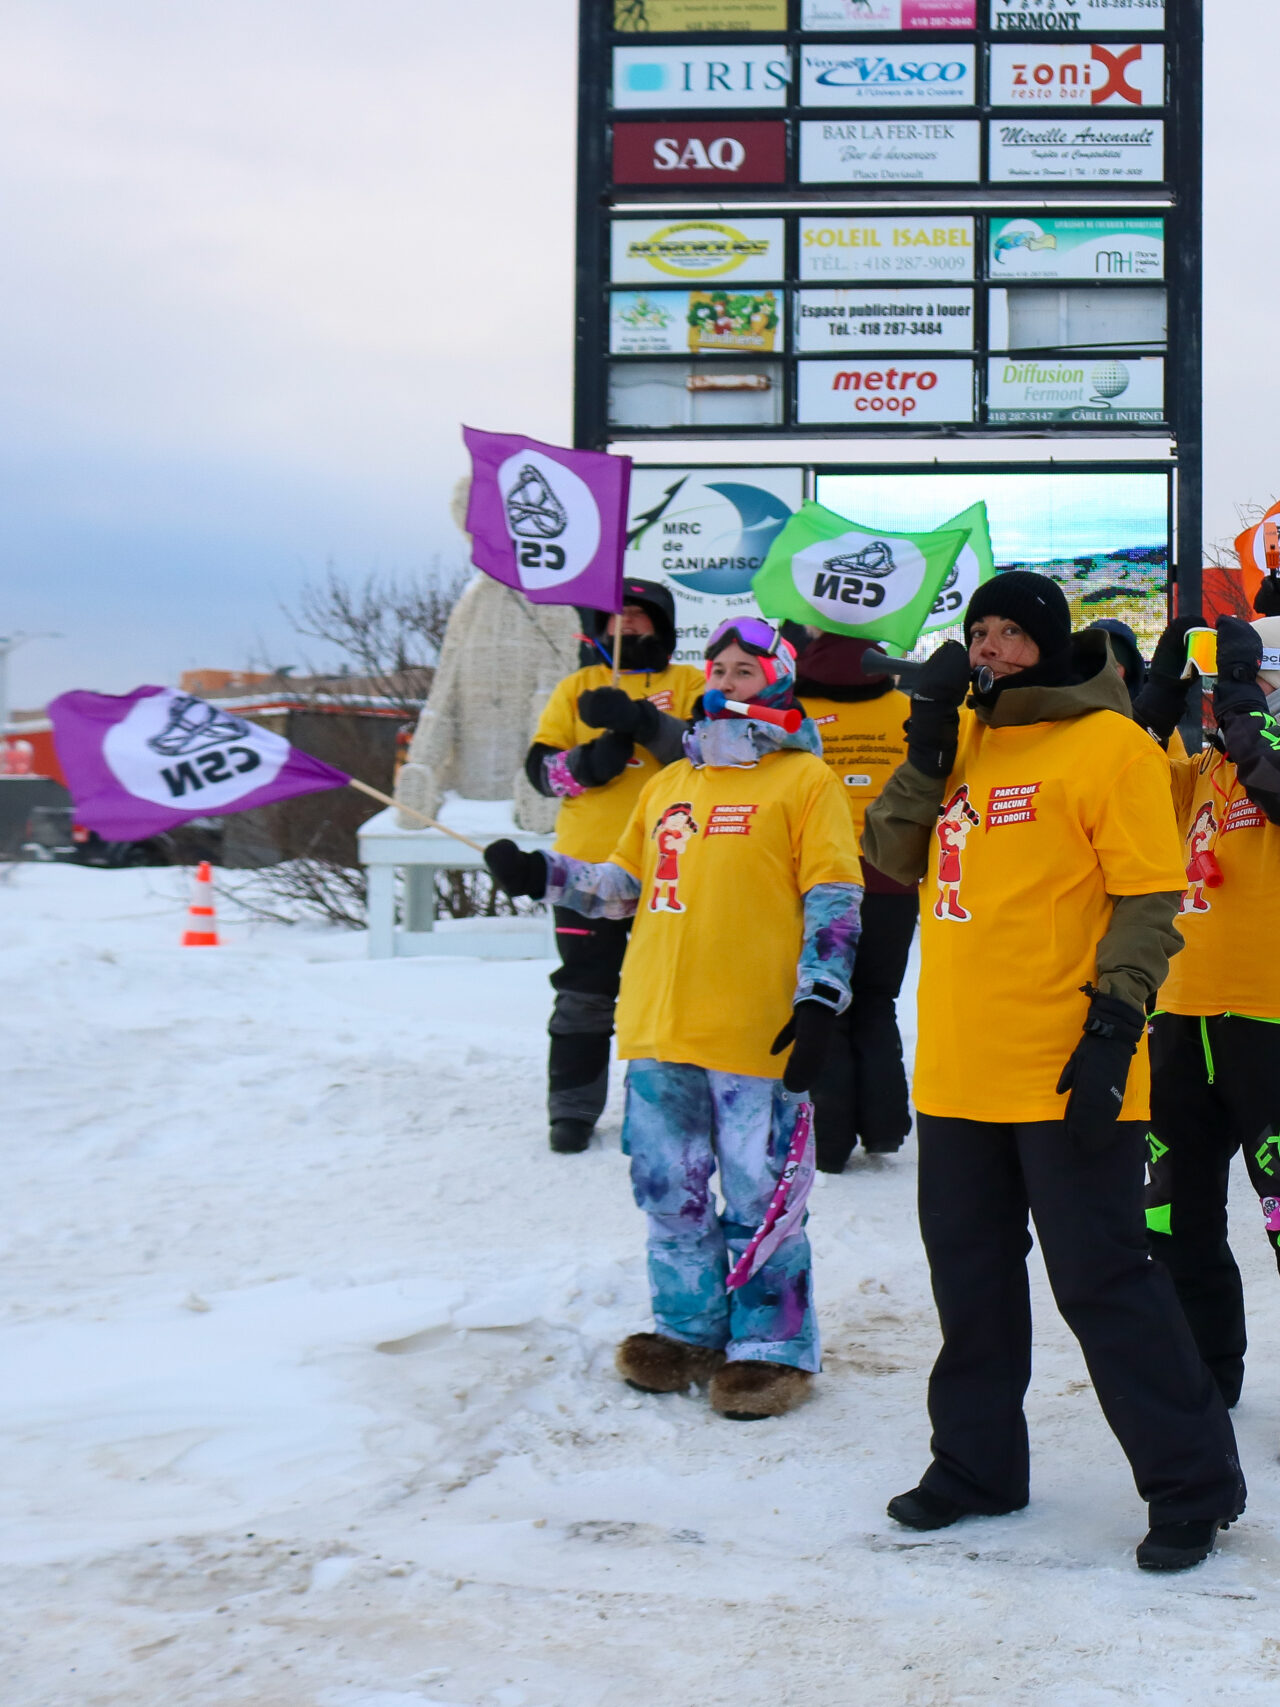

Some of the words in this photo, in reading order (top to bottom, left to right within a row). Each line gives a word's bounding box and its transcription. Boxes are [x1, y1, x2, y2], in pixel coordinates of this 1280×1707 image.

[996, 12, 1080, 30] FERMONT
[681, 60, 787, 91] IRIS
[853, 57, 967, 82] VASCO
[1011, 88, 1052, 98] resto
[1059, 88, 1086, 98] bar
[823, 125, 857, 139] BAR
[860, 125, 884, 139] LA
[887, 124, 955, 140] FER-TEK
[1000, 126, 1068, 144] Mireille
[1070, 126, 1154, 145] Arsenault
[653, 137, 746, 172] SAQ
[803, 228, 882, 247] SOLEIL
[893, 228, 972, 247] ISABEL
[810, 254, 849, 271] TÉL.
[863, 257, 891, 271] 418
[895, 257, 966, 271] 287-9009
[801, 304, 845, 318] Espace
[849, 303, 924, 318] publicitaire
[926, 303, 935, 316] à
[937, 303, 971, 316] louer
[859, 323, 881, 335] 418
[884, 322, 943, 336] 287-3484
[832, 368, 937, 391] metro
[1002, 363, 1085, 384] Diffusion
[1024, 386, 1085, 401] Fermont
[855, 397, 916, 416] coop
[1116, 412, 1164, 421] INTERNET
[663, 522, 702, 535] MRC
[662, 539, 684, 552] de
[675, 624, 710, 639] erté
[995, 788, 1020, 797] PARCE
[1020, 785, 1036, 794] QUE
[992, 798, 1028, 811] CHACUNE
[1228, 806, 1257, 820] CHACUNE
